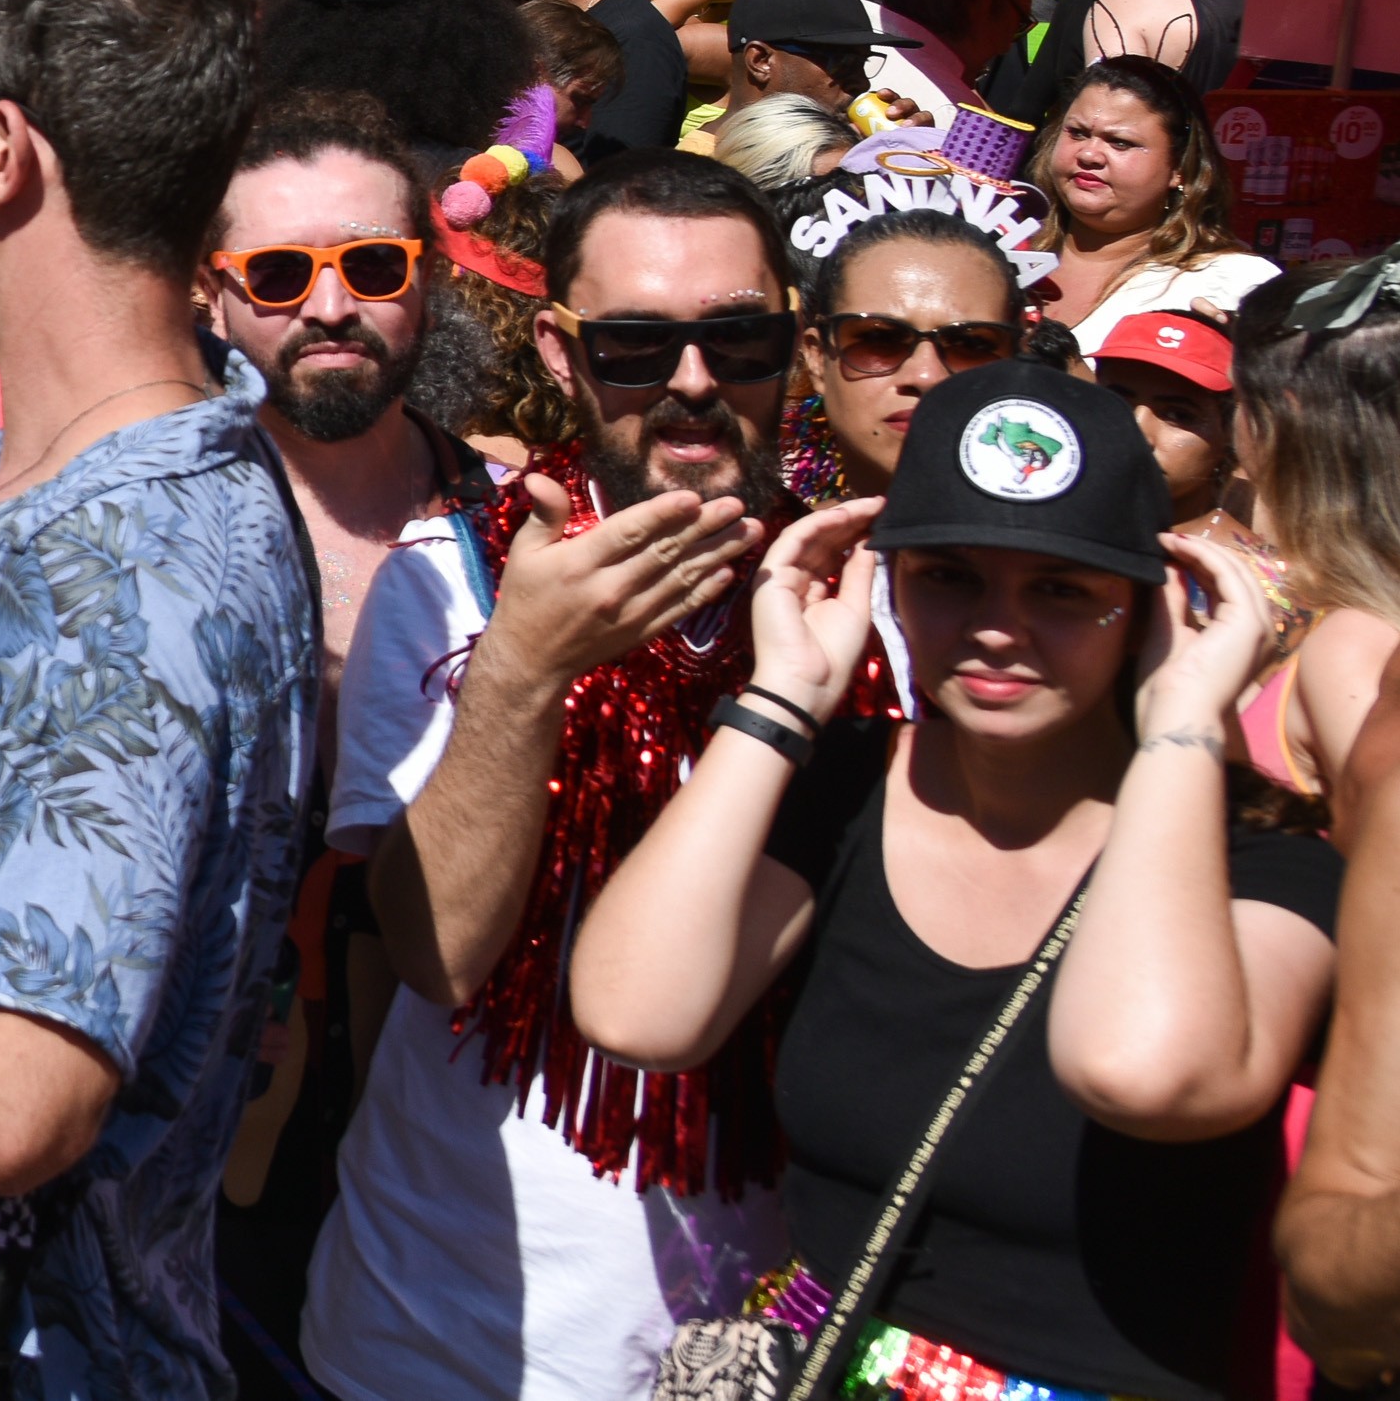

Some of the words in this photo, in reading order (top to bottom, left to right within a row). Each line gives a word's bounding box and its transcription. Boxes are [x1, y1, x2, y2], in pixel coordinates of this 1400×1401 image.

[978, 1023, 1008, 1055] PELO
[964, 1052, 989, 1075] SOL
[908, 1140, 935, 1174] PELO
[895, 1169, 920, 1195] SOL
[847, 1258, 874, 1294] PELO
